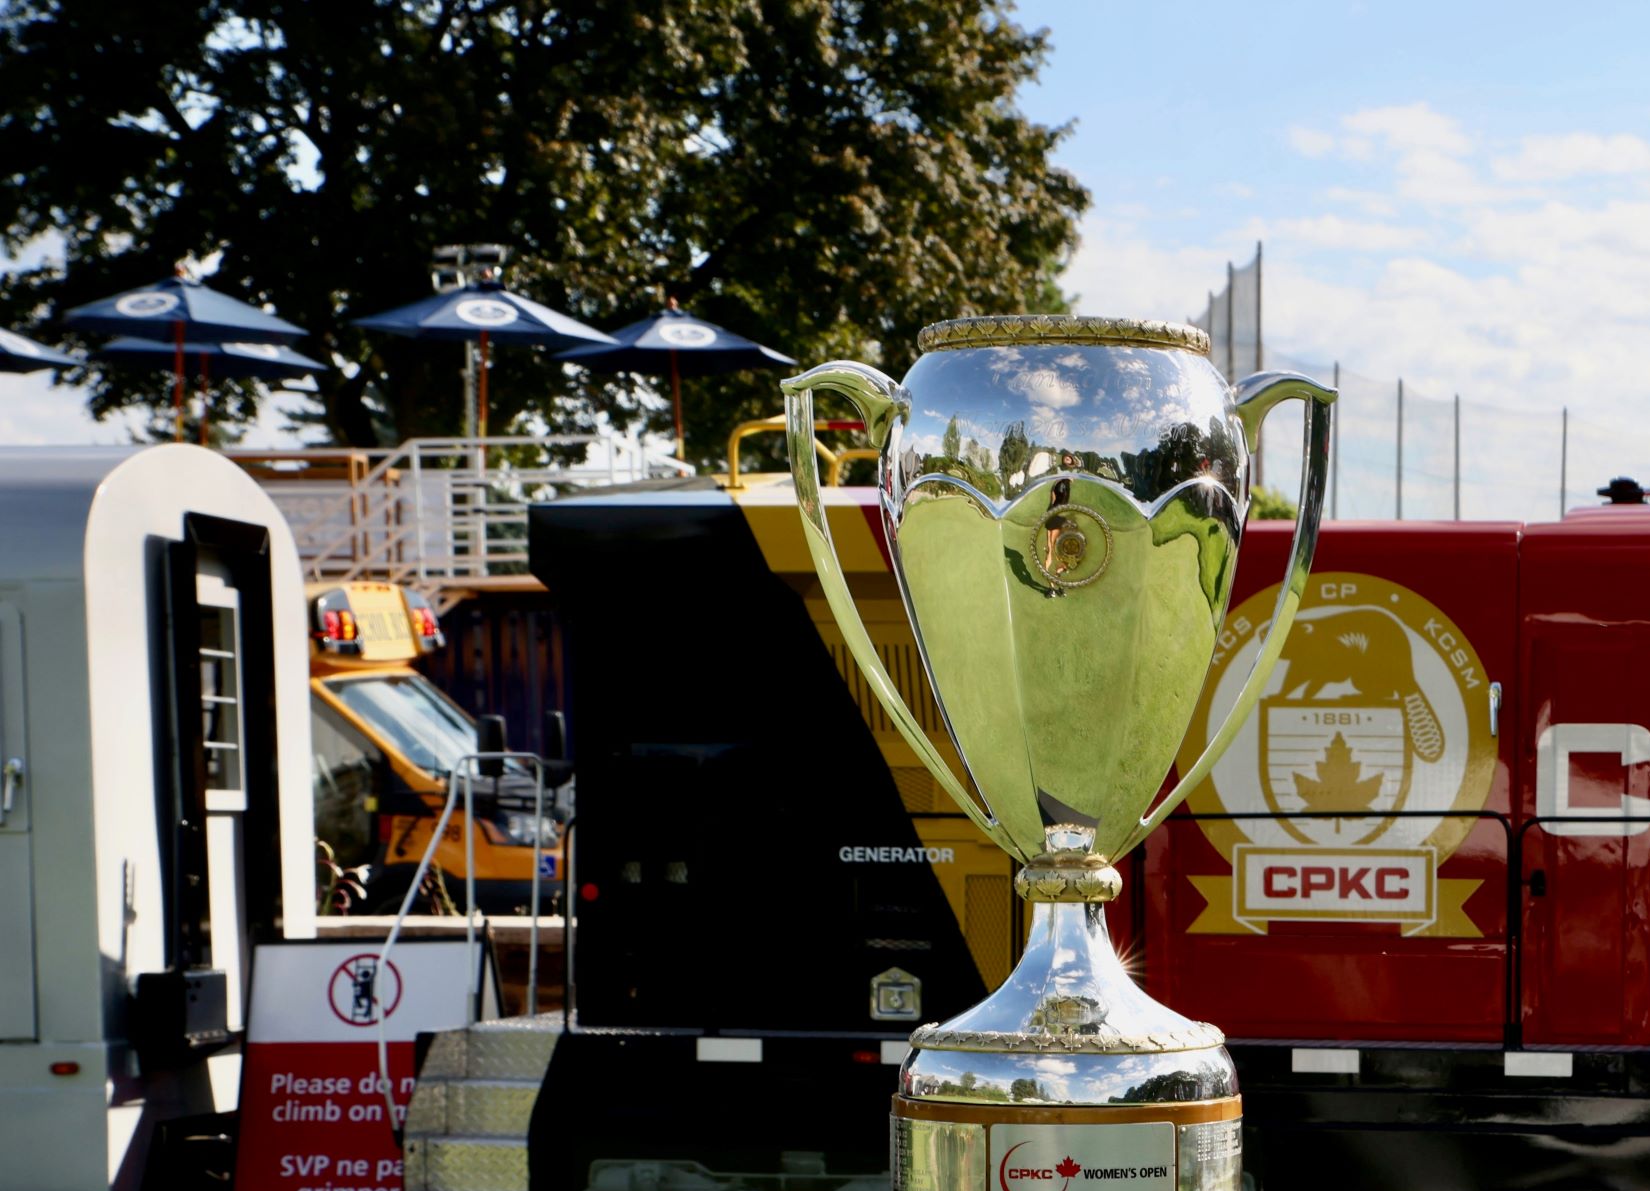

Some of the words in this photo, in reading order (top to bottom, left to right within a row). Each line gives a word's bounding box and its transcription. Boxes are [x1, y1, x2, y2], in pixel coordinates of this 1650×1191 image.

[1320, 583, 1357, 600] CP
[1423, 618, 1481, 689] KCSM
[1314, 712, 1361, 725] 1881
[839, 846, 954, 863] GENERATOR
[1263, 866, 1410, 900] CPKC
[270, 1072, 352, 1095] Please
[358, 1071, 393, 1095] do
[272, 1099, 341, 1122] climb
[348, 1104, 382, 1122] on
[280, 1154, 330, 1177] SVP
[336, 1159, 369, 1177] ne
[376, 1159, 405, 1182] pa
[1008, 1168, 1053, 1180] CPKC
[1083, 1167, 1137, 1180] WOMEN'S
[1139, 1167, 1167, 1178] OPEN
